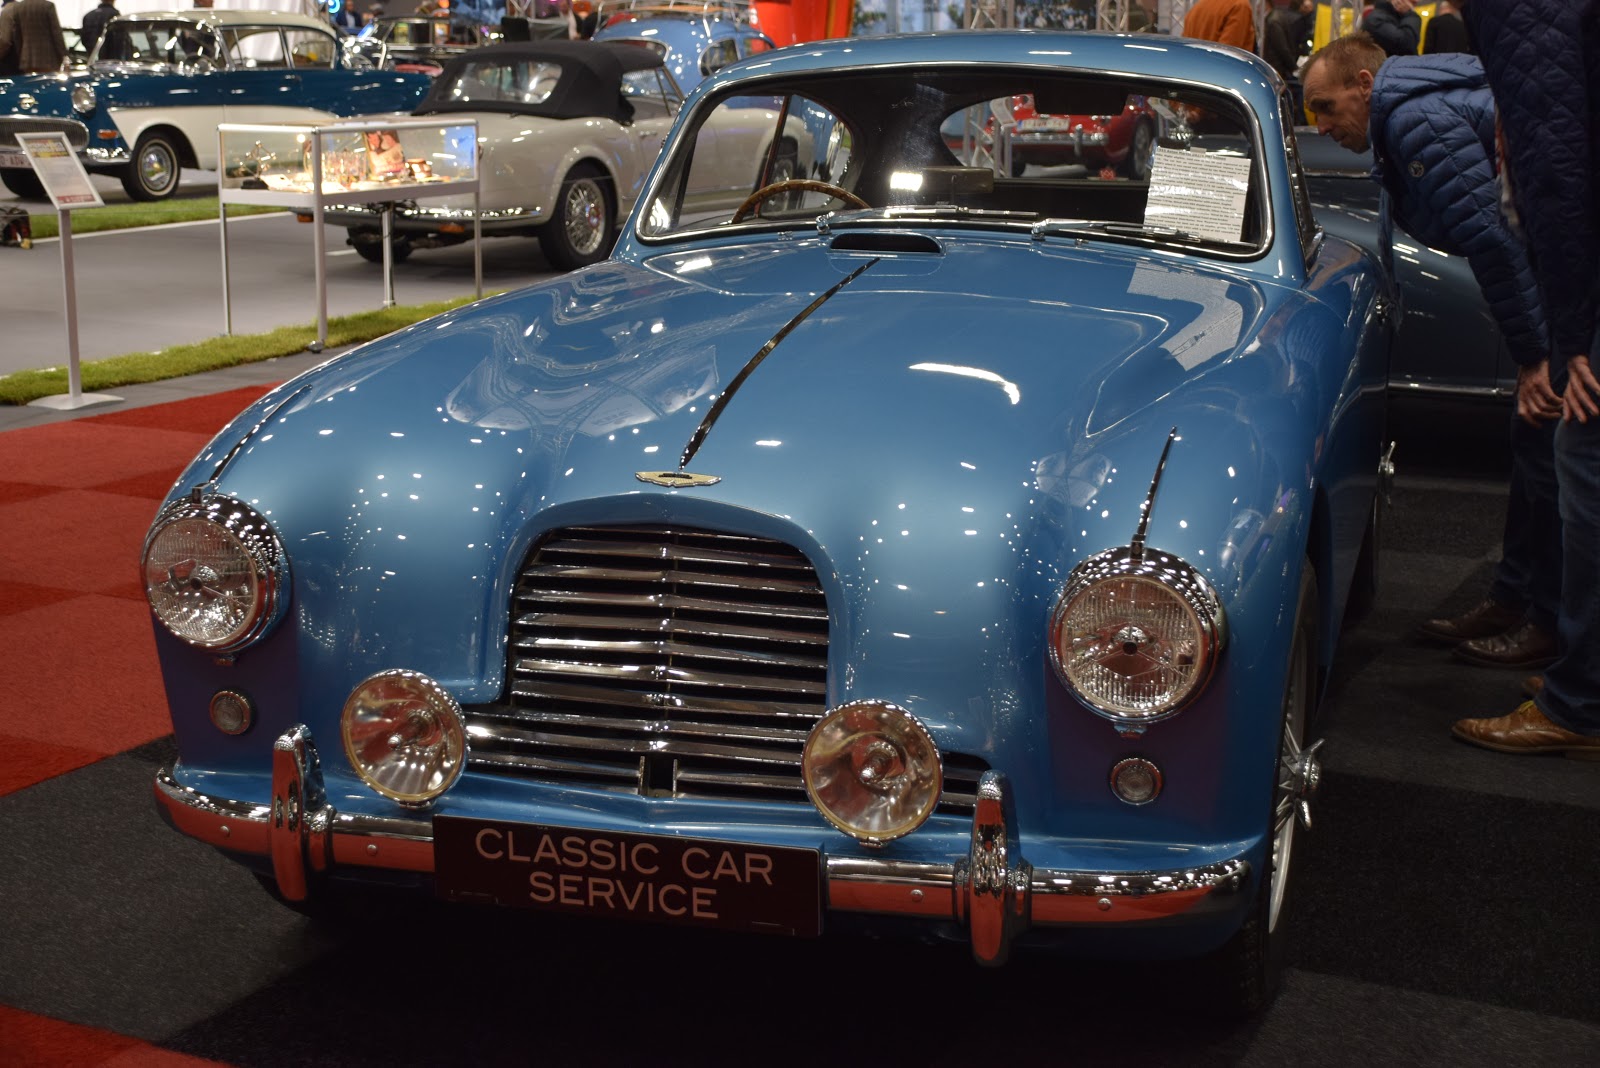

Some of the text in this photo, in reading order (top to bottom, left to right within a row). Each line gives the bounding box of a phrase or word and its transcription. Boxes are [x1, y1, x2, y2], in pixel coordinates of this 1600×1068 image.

[475, 828, 773, 885] CLASSIC CAR
[529, 872, 719, 919] SERVICE
